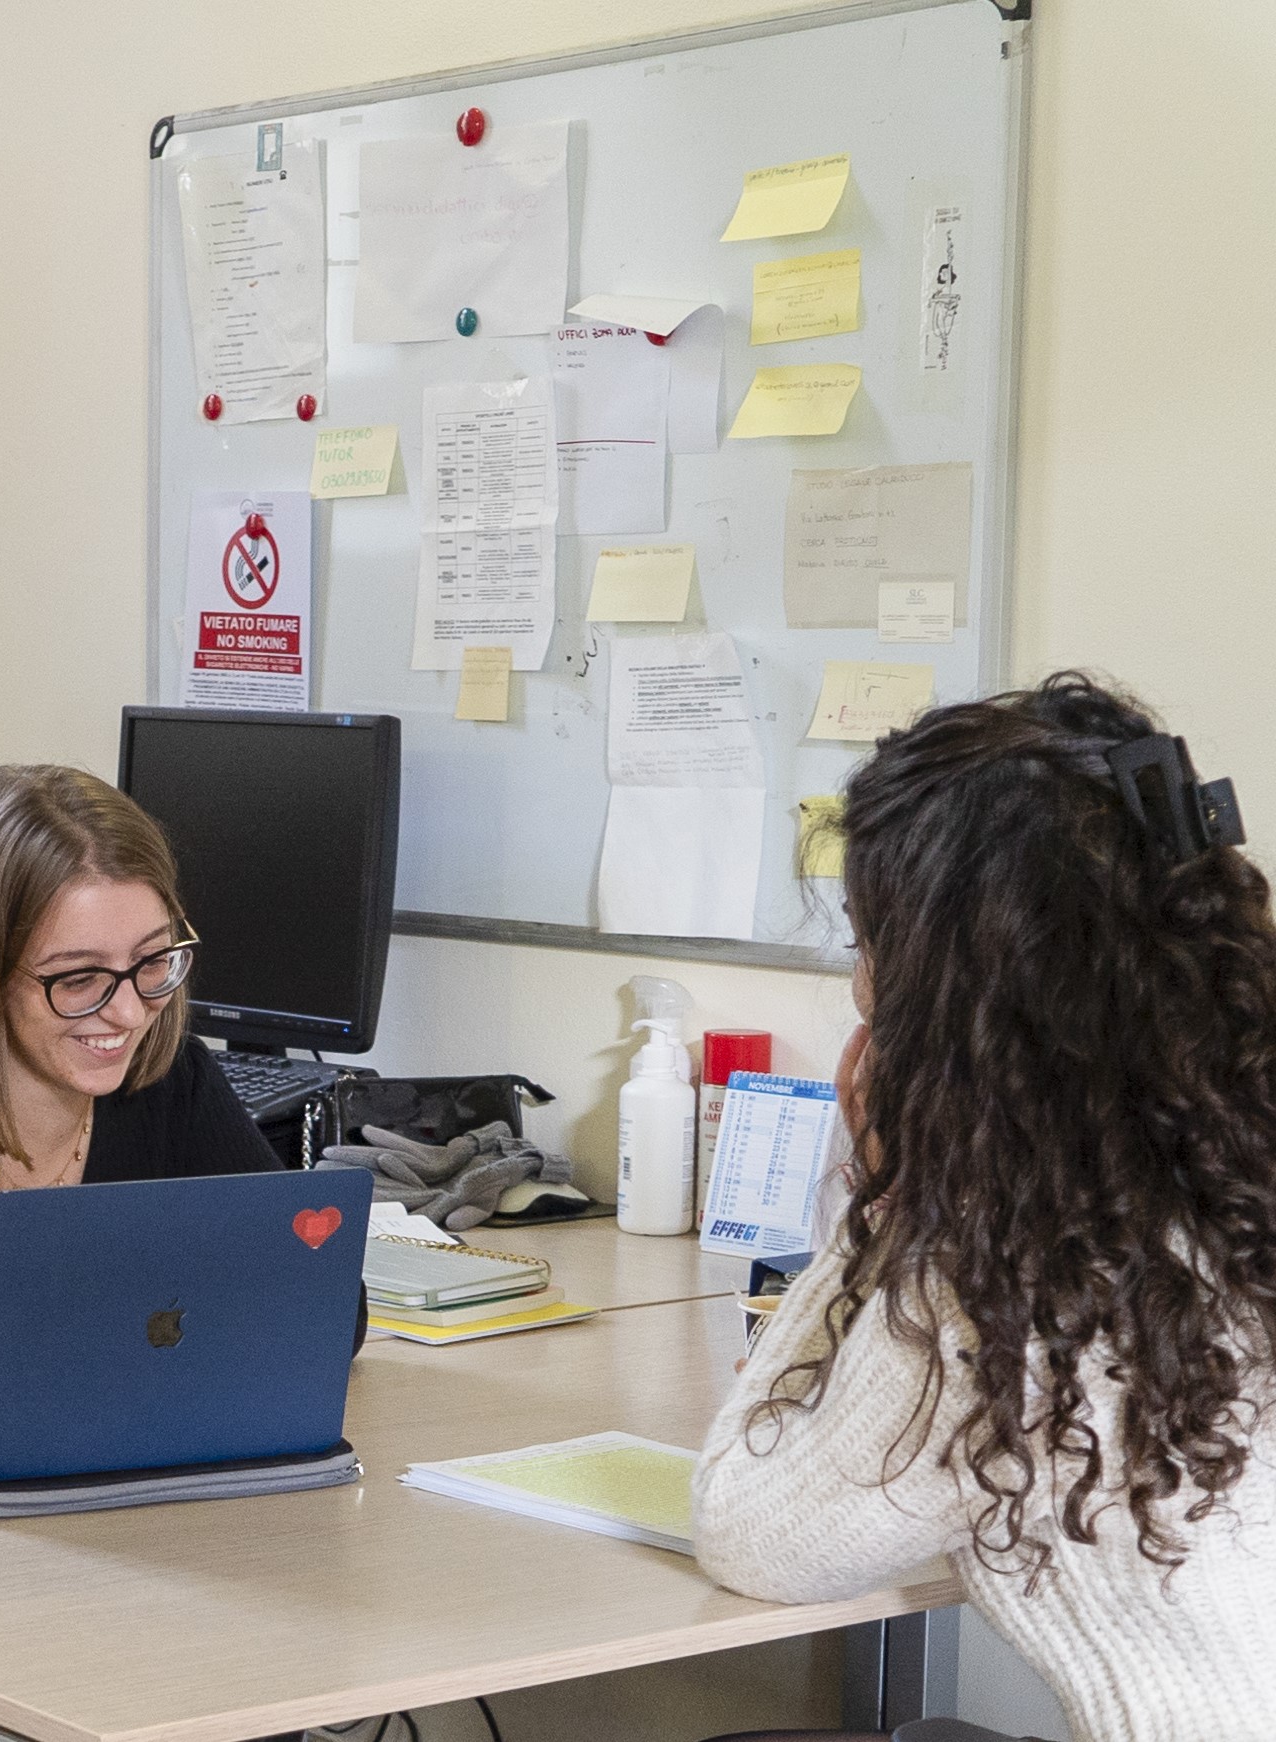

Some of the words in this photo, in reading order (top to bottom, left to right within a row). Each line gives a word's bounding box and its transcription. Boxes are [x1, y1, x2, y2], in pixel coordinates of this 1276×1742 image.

[557, 329, 588, 341] UFFICI
[203, 615, 254, 630] VIETATO
[256, 618, 298, 633] FUMARE
[216, 634, 235, 648] NO
[237, 635, 288, 650] SMOKING
[210, 1008, 241, 1020] SAMSUNG
[748, 1081, 793, 1095] NOVEMBRE
